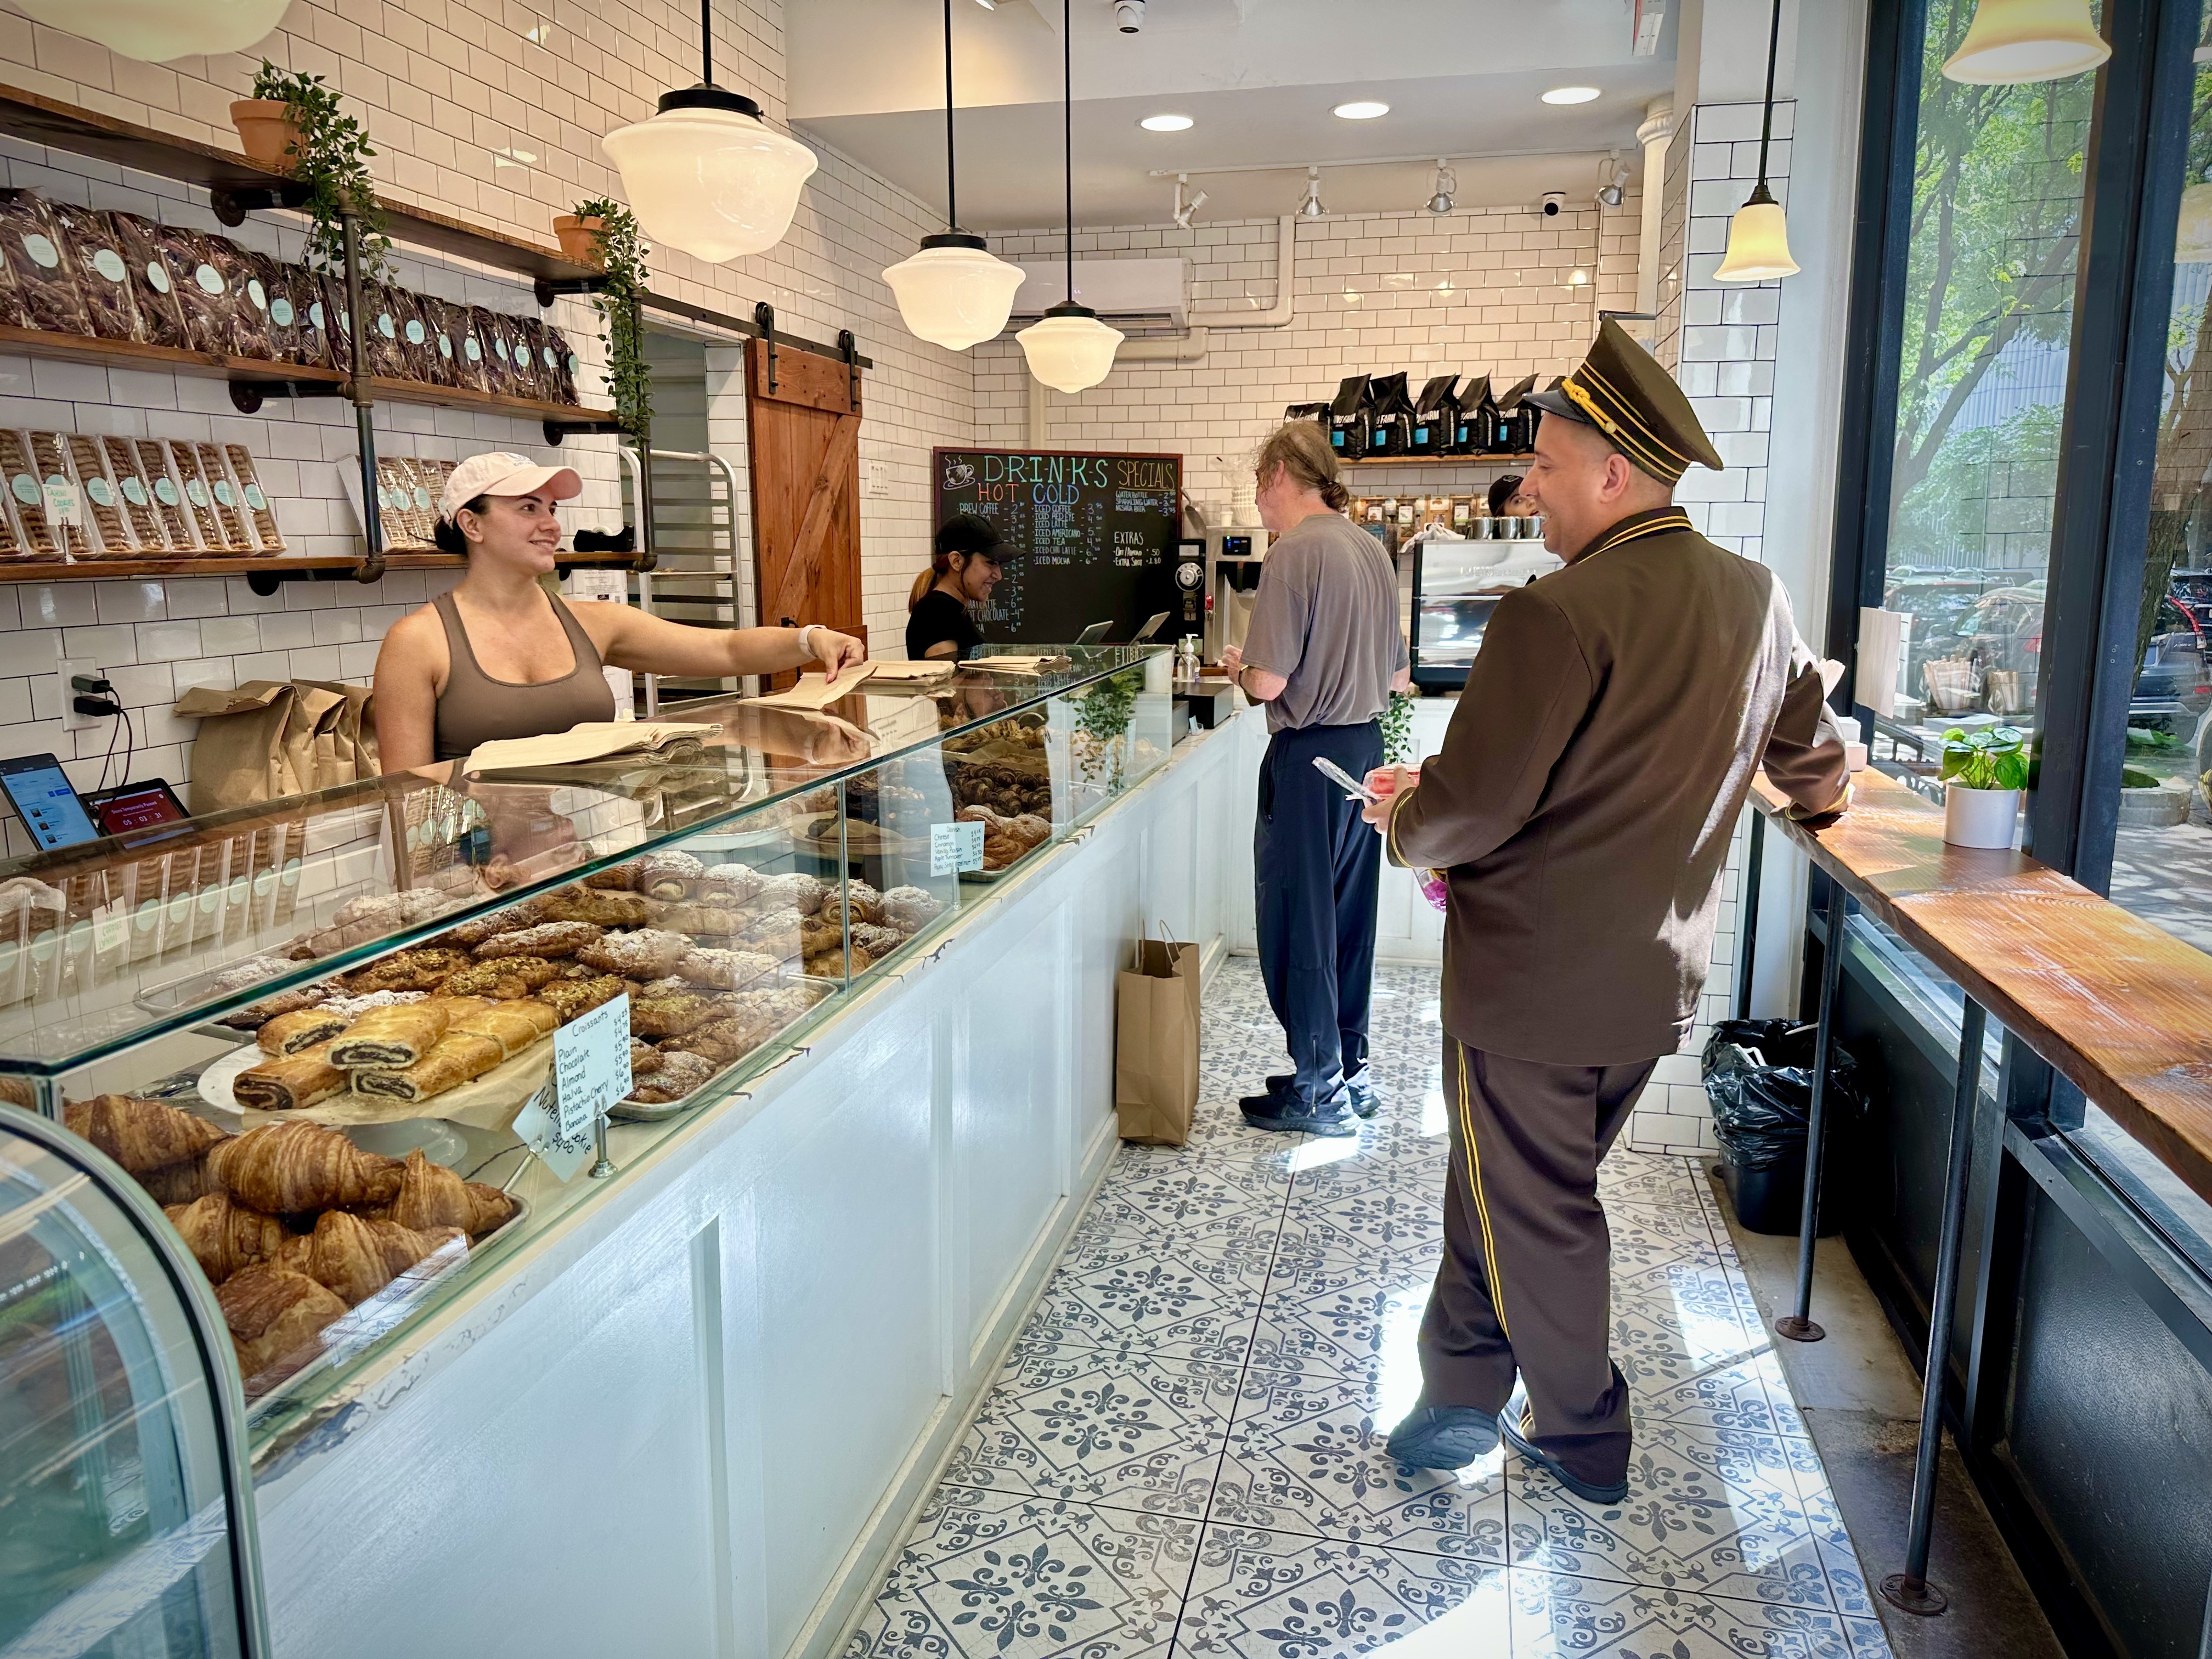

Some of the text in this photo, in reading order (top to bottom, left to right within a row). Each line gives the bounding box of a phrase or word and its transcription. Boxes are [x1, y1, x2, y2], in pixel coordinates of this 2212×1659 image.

[1380, 413, 1396, 424] FARM
[1117, 460, 1175, 490] SPECIALS
[977, 483, 1019, 503] HOT
[1032, 483, 1080, 505] COLD
[979, 502, 999, 515] COFFEE
[1034, 504, 1051, 514] ICED
[1052, 504, 1071, 514] COFFEE
[1035, 520, 1068, 528] ICED LATTE
[1035, 528, 1051, 537] ICED
[1052, 529, 1081, 538] AMERICANO
[1114, 531, 1144, 545] EXTRAS
[1053, 537, 1065, 546] TEA
[1035, 546, 1049, 554] ICED
[1035, 556, 1051, 565] ICED
[1052, 556, 1070, 565] MOCHA
[977, 608, 1009, 622] CHOCOLATE
[122, 804, 144, 812] Temporarily
[572, 1010, 608, 1037] Croissants
[558, 1046, 578, 1062] Plain
[559, 1049, 590, 1074] Chocolate
[562, 1065, 586, 1091] Almond
[562, 1086, 583, 1104] Halva
[563, 1095, 591, 1119] Pistachio
[590, 1079, 608, 1099] Cherry
[565, 1114, 588, 1132] Banana
